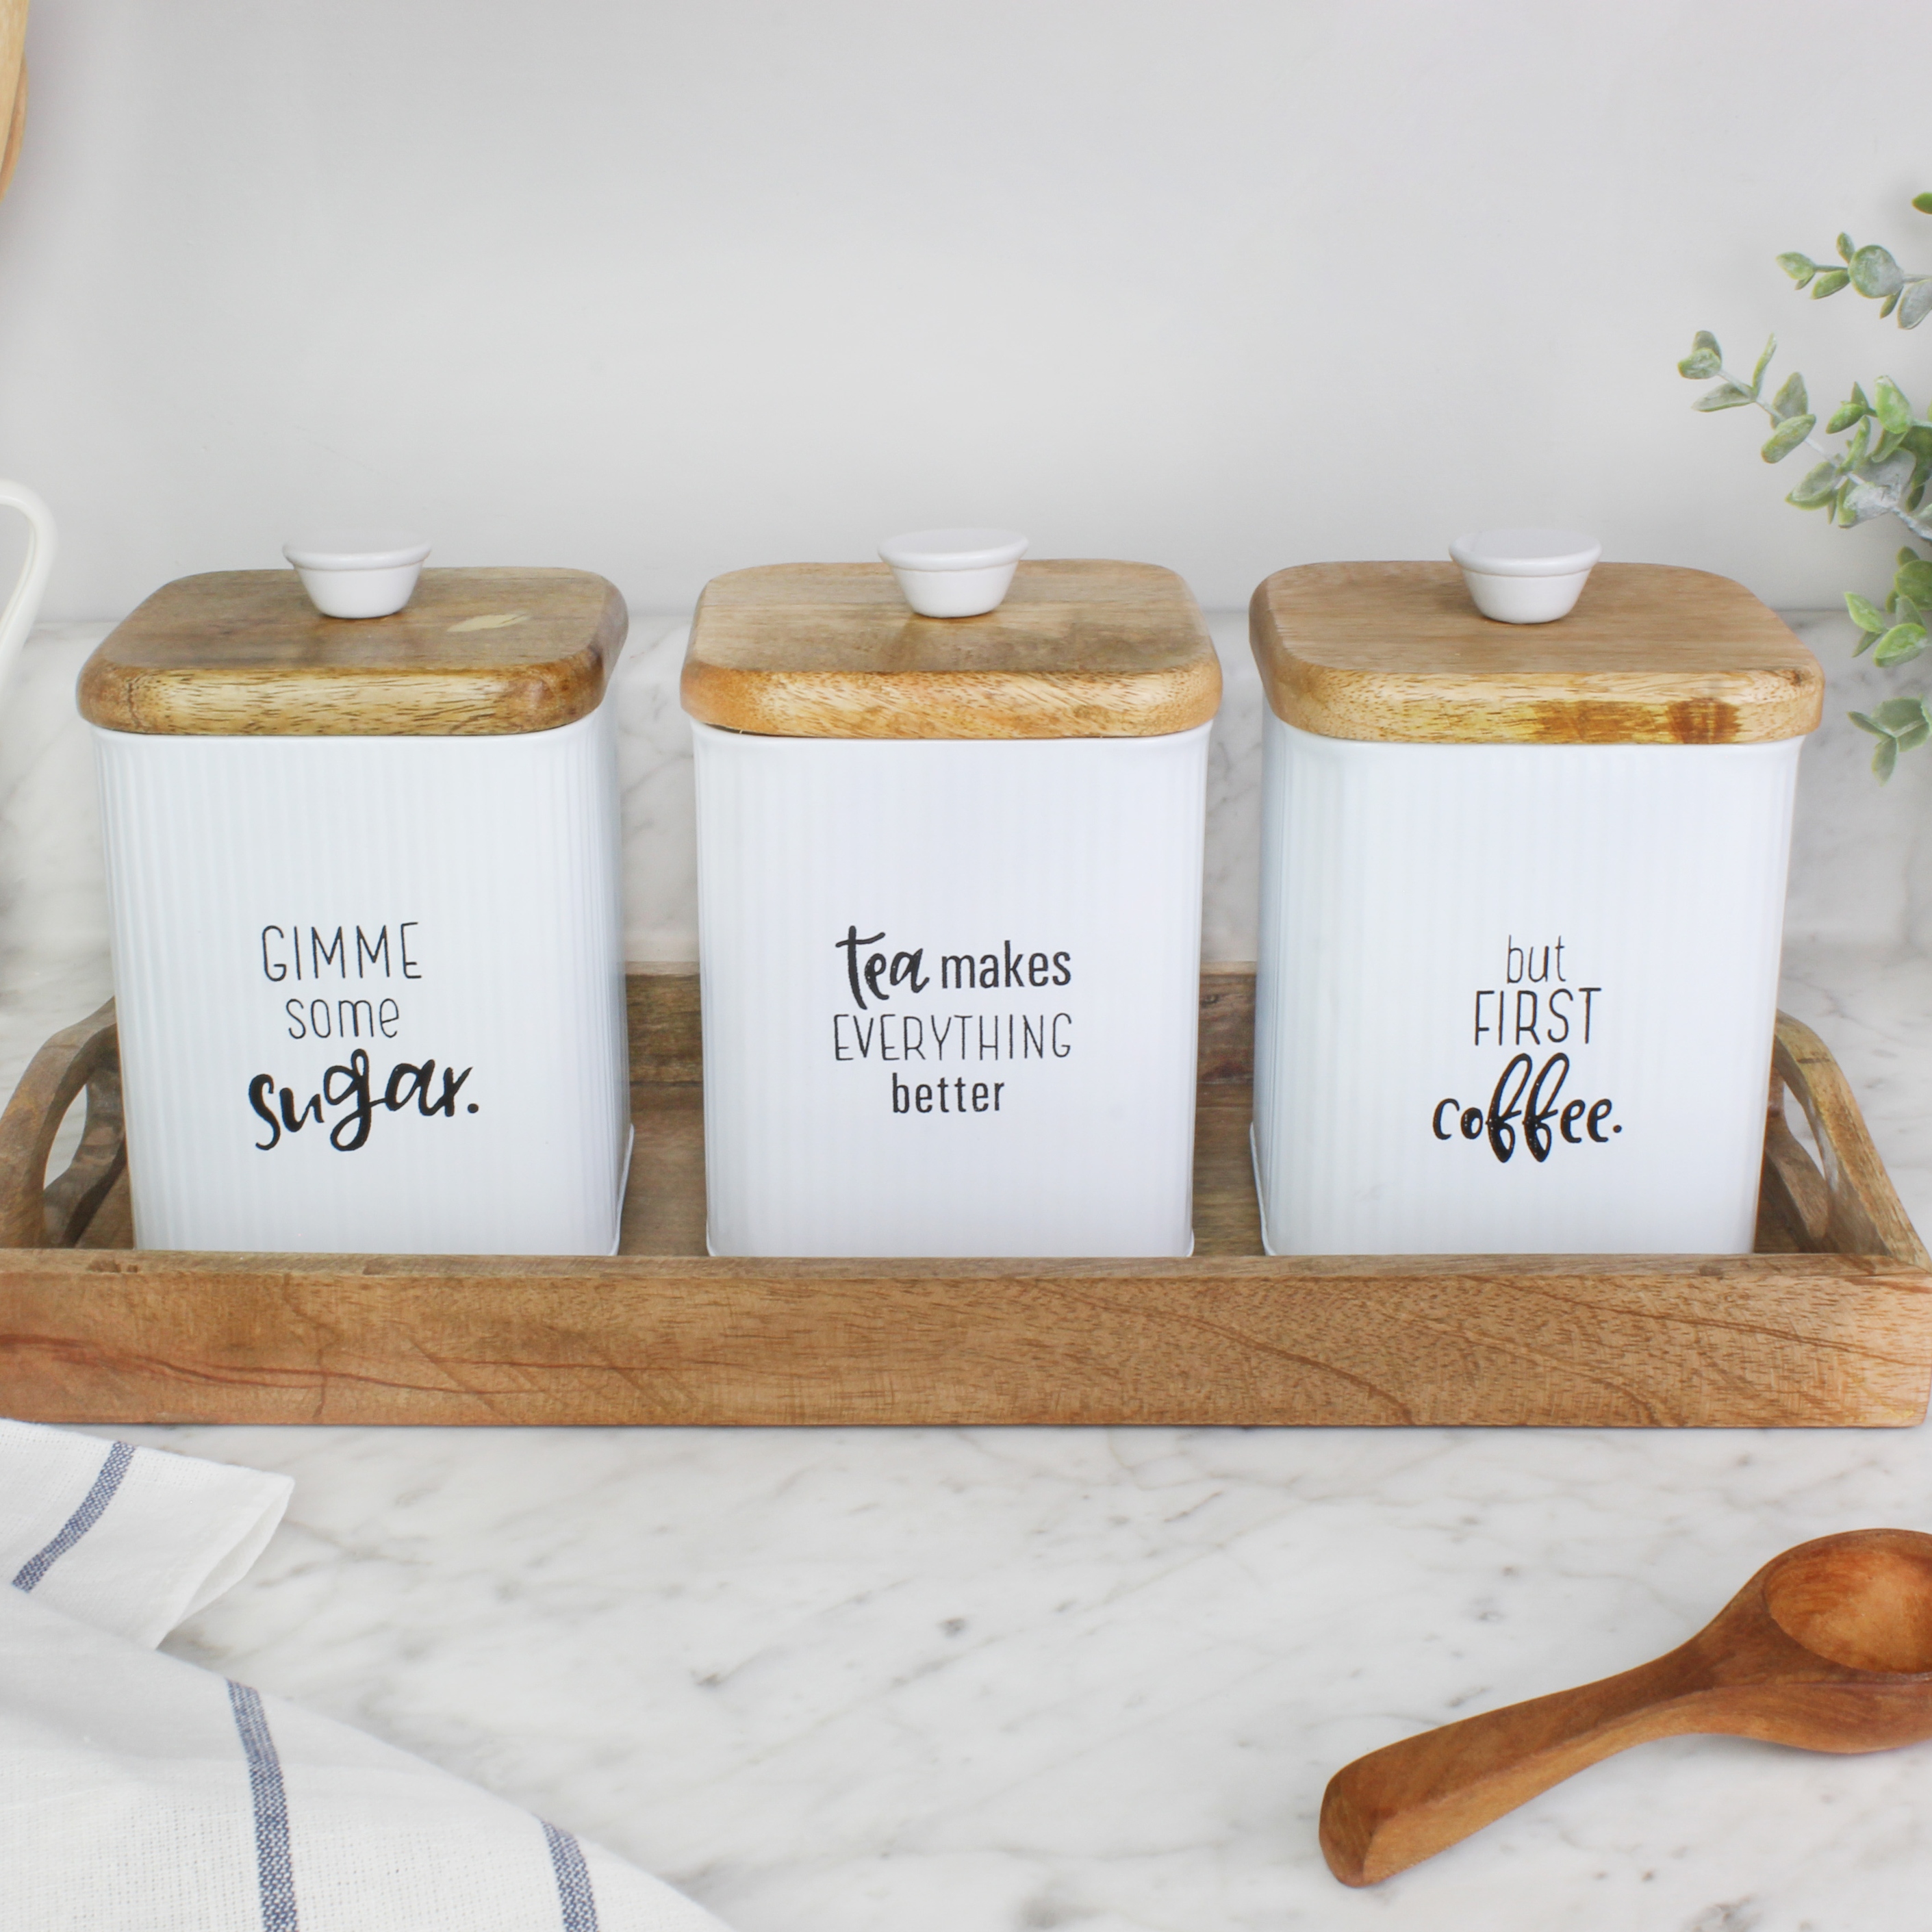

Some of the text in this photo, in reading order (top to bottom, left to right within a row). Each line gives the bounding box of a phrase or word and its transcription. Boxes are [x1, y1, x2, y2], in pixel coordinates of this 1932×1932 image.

[262, 921, 422, 982] GIMME
[835, 925, 1072, 1011] tea makes
[1507, 935, 1567, 984] but
[285, 997, 400, 1040] some
[833, 1013, 1073, 1061] EVERYTHING
[1474, 987, 1603, 1047] FIRST
[248, 1048, 480, 1152] sugar.
[892, 1072, 1006, 1114] better
[1432, 1052, 1623, 1164] coffee.
